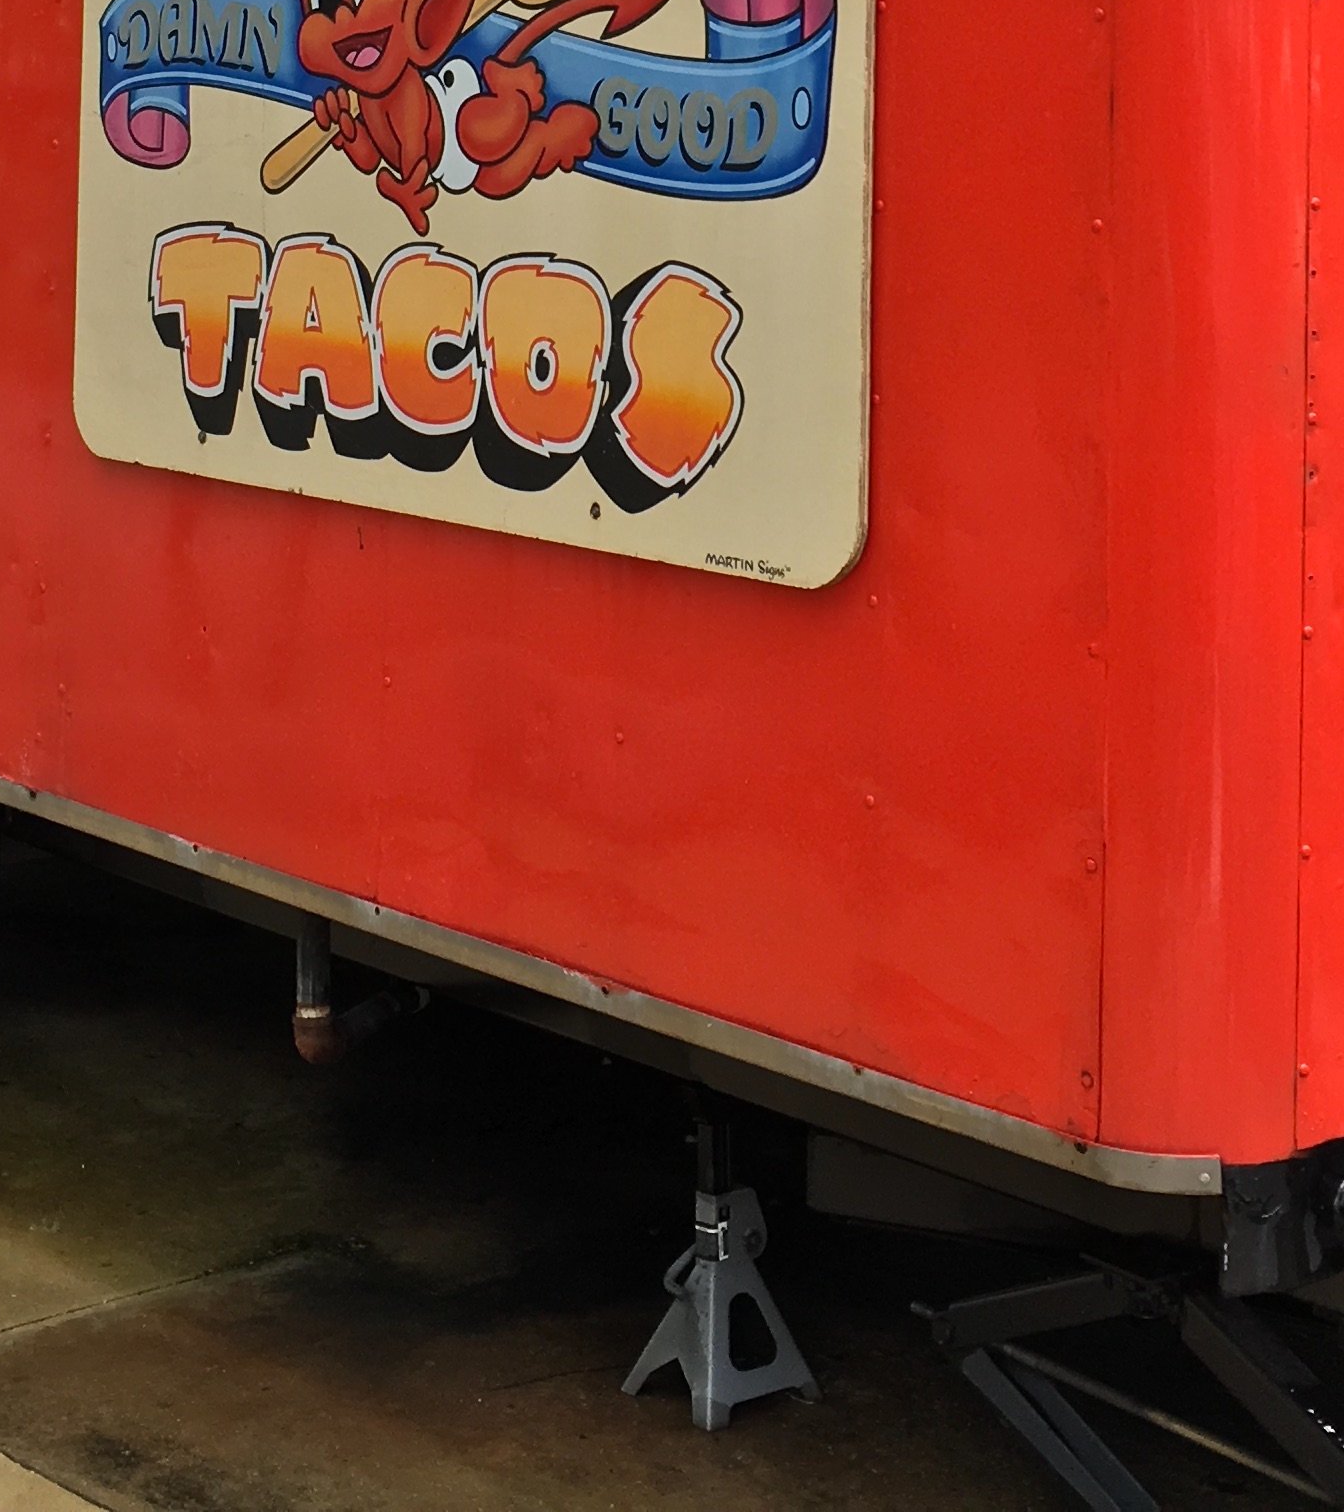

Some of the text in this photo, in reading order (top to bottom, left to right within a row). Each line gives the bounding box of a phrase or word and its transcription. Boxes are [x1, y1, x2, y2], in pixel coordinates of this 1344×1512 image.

[590, 76, 778, 172] GOOD
[149, 221, 745, 514] TACOS
[705, 553, 754, 572] MARTIN
